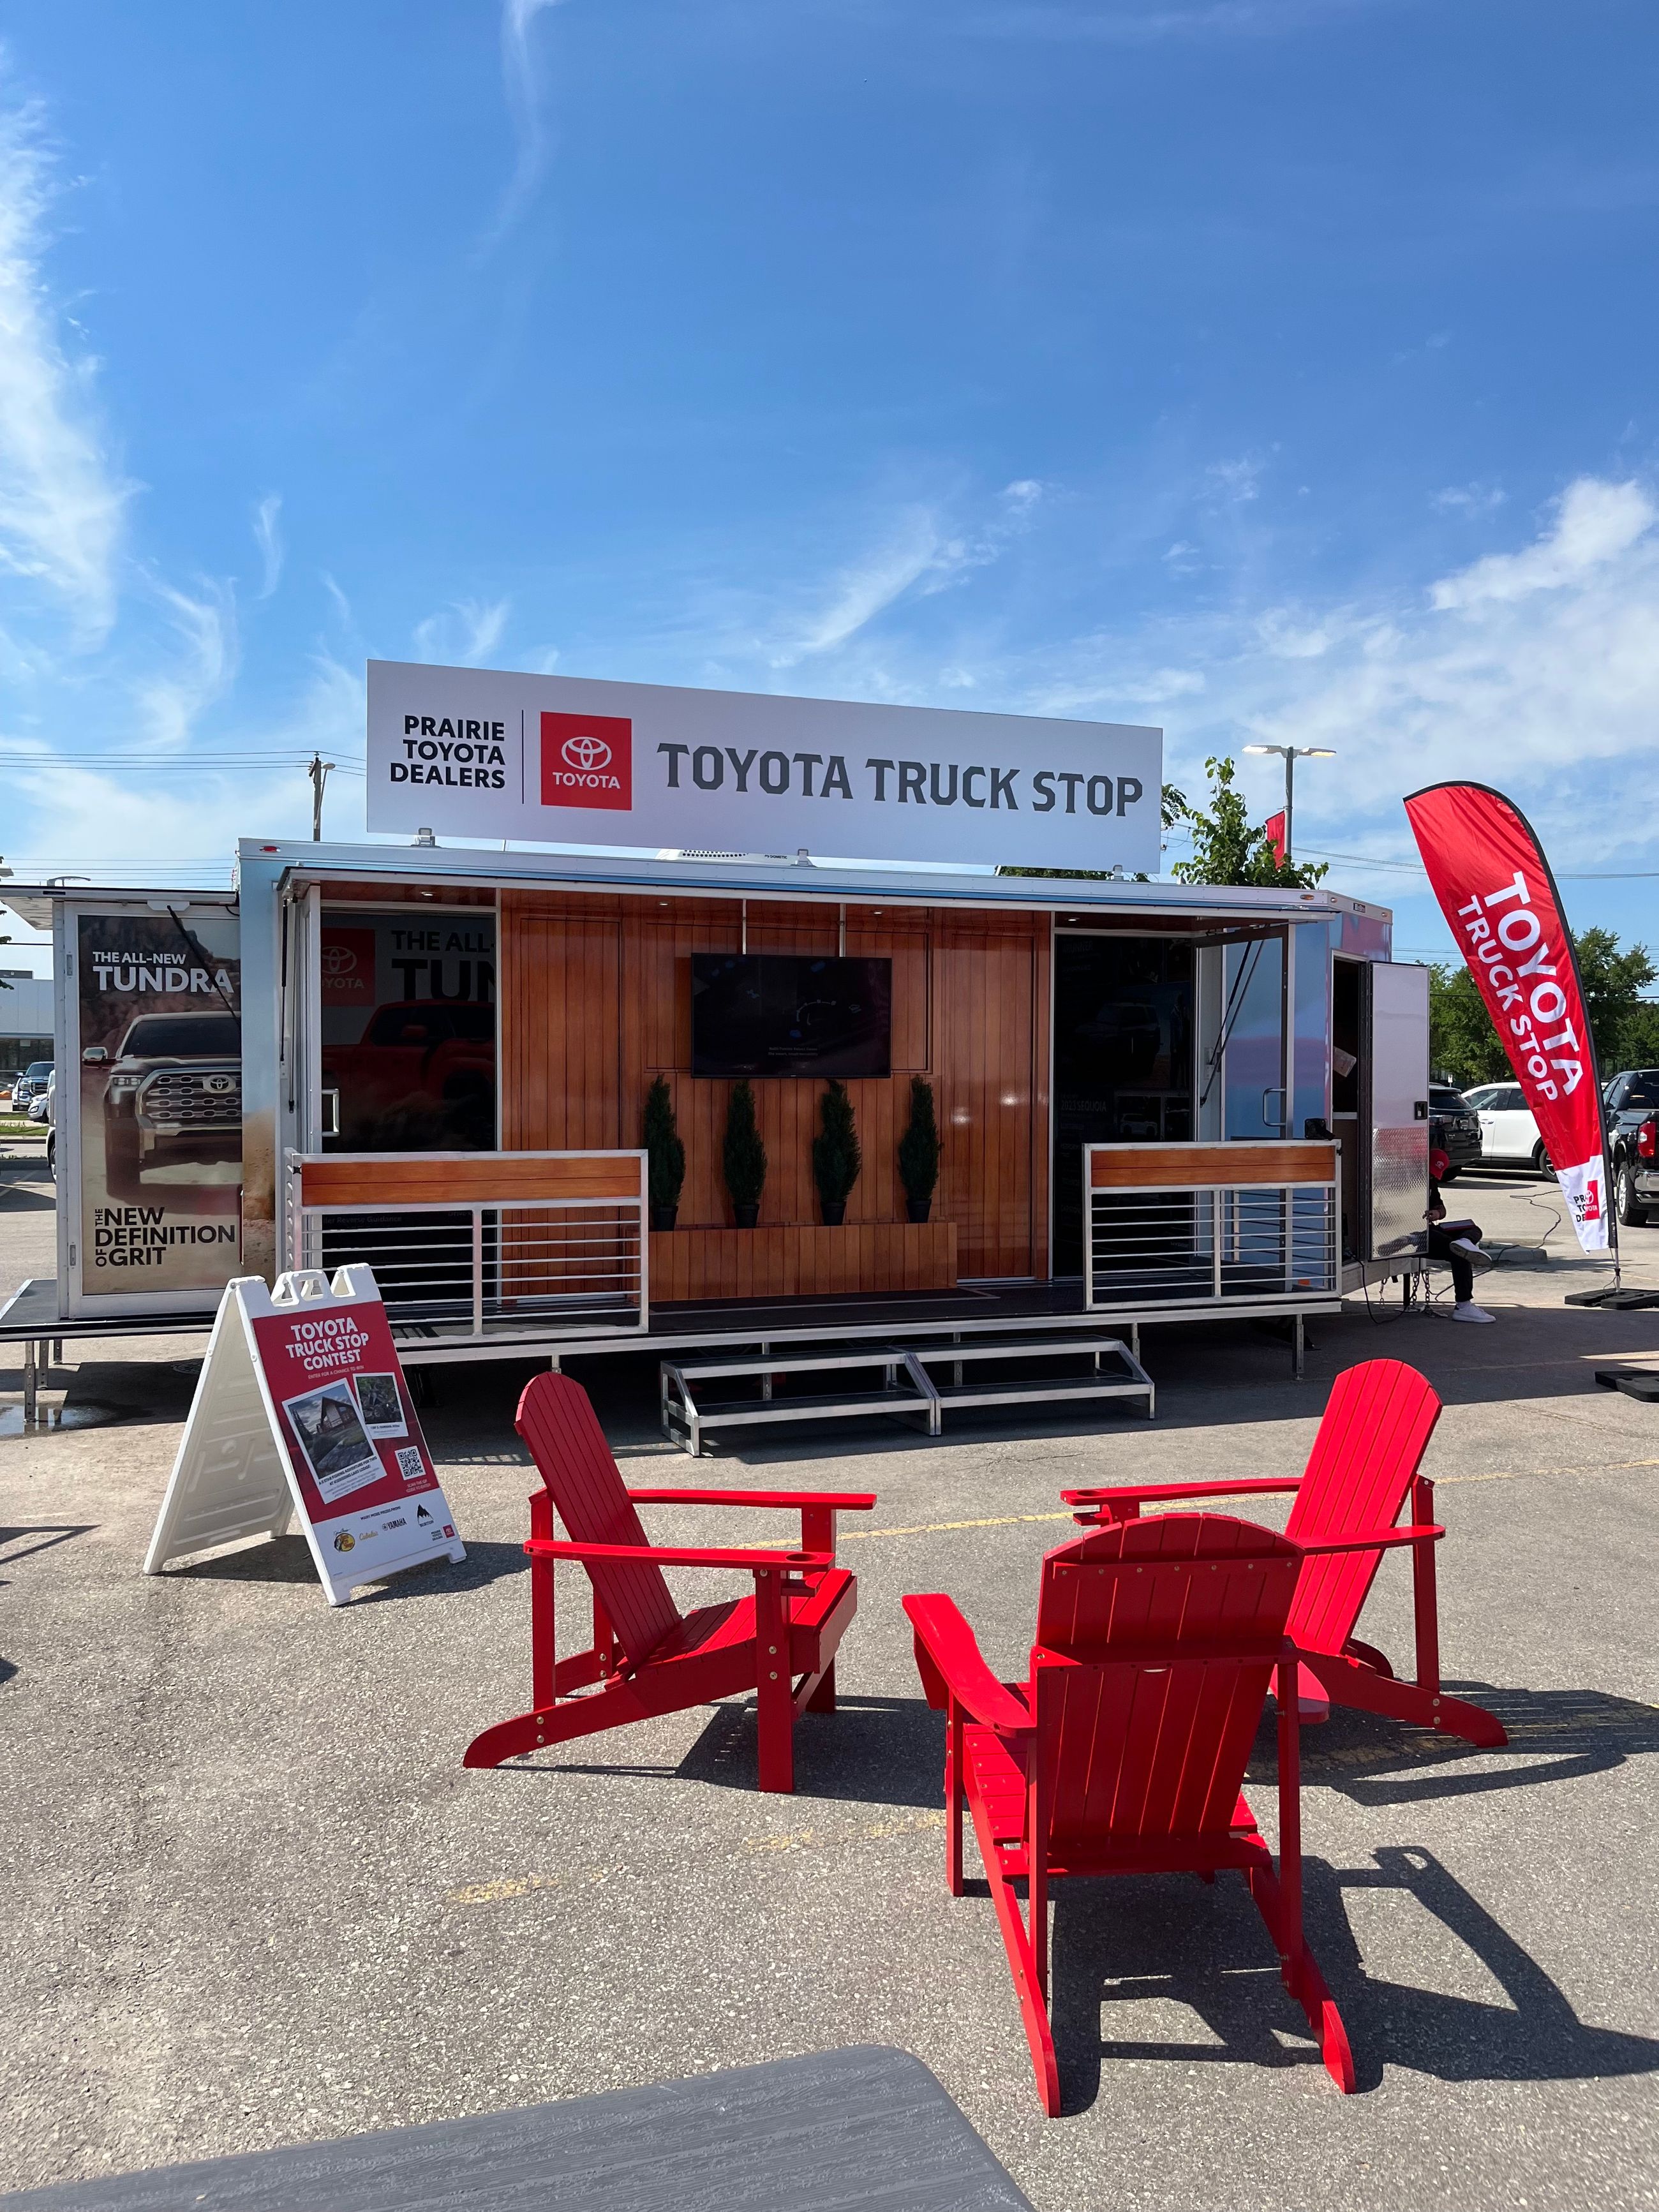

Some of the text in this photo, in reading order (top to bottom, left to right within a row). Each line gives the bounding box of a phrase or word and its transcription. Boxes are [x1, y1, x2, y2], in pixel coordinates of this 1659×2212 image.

[404, 715, 505, 741] PRAIRIE
[403, 739, 506, 766] TOYOTA
[390, 763, 506, 789] DEALERS
[553, 771, 621, 790] TOYOTA
[657, 743, 1143, 817] TOYOTA TRUCK STOP
[391, 930, 440, 951] THE
[93, 951, 186, 965] THE ALL-NEW
[93, 965, 234, 993] TUNDRA
[1484, 871, 1584, 1095] TOYOTA
[1457, 894, 1558, 1101] TRUCK STOP
[95, 1208, 103, 1227] THE
[104, 1207, 165, 1226] NEW
[95, 1225, 235, 1247] DEFINITION
[96, 1249, 107, 1267] OF
[108, 1247, 167, 1266] GRIT
[290, 1317, 358, 1341] TOYOTA
[285, 1332, 369, 1358] TRUCK STOP
[303, 1349, 361, 1370] CONTEST
[387, 1517, 408, 1530] YAMAHA
